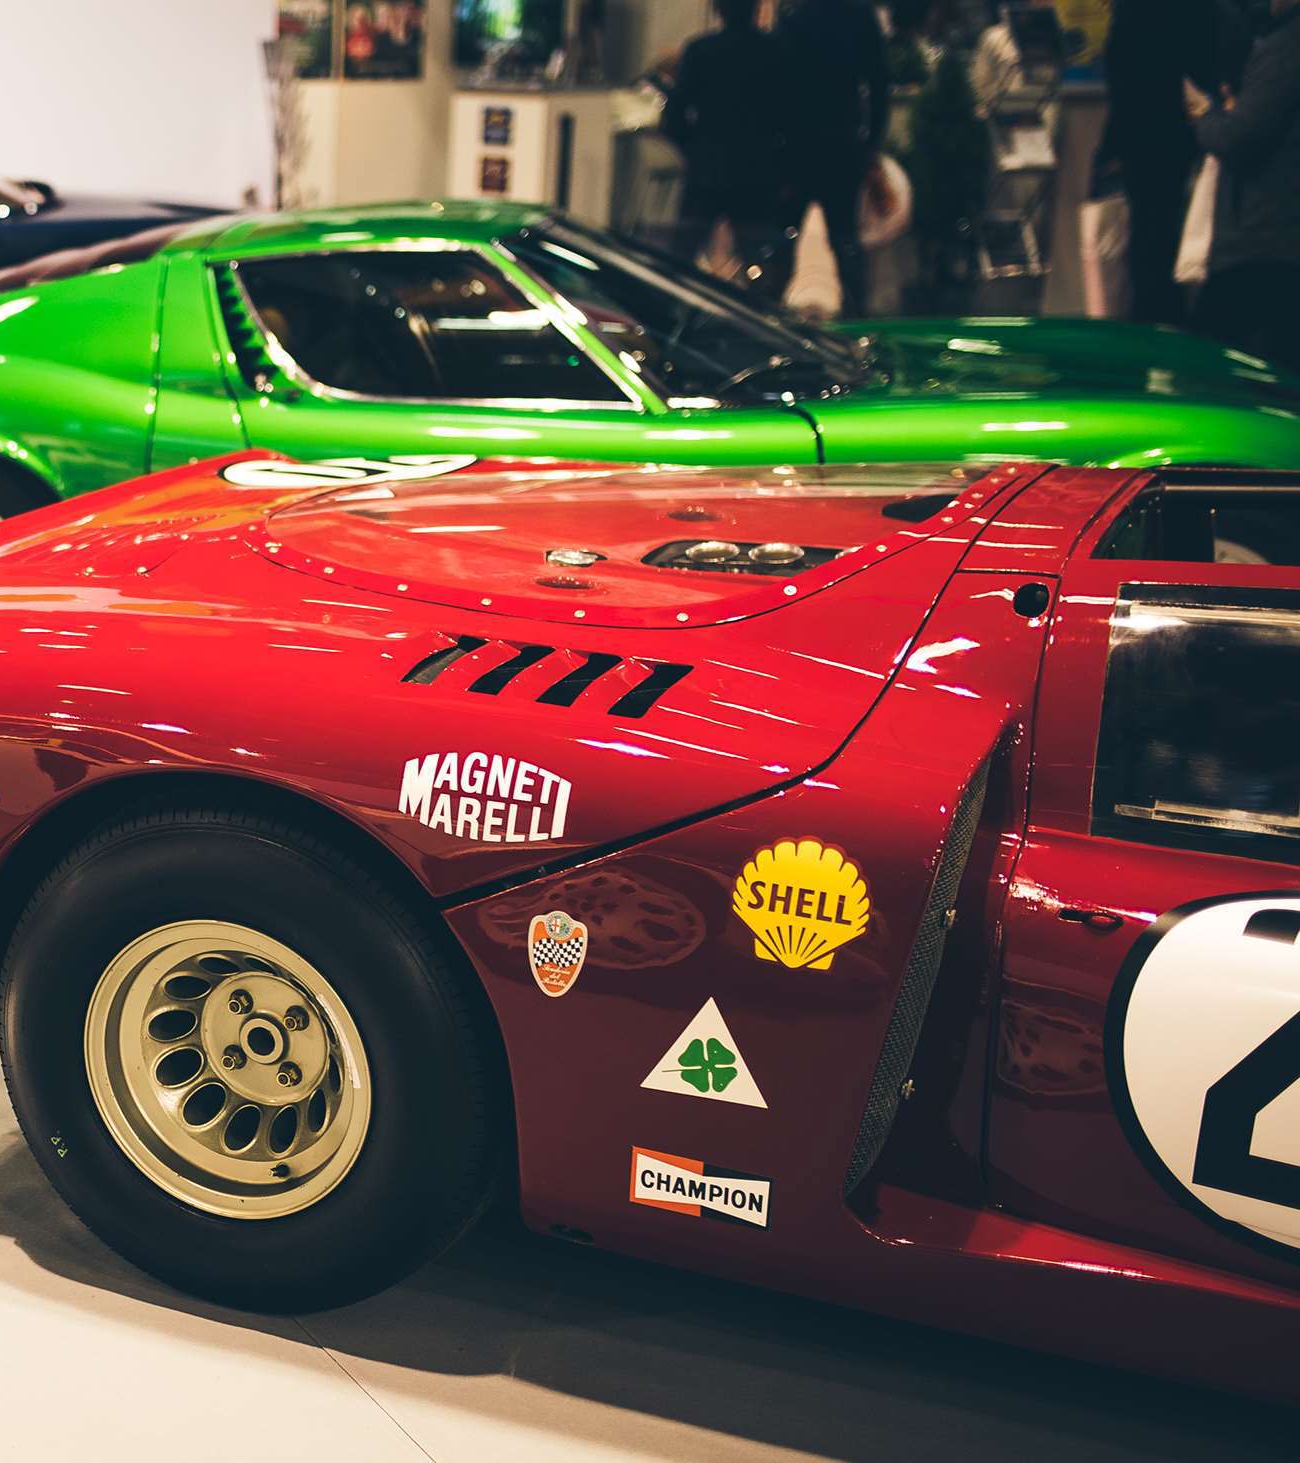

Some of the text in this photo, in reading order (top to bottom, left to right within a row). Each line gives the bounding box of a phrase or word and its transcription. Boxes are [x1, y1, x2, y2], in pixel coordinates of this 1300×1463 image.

[399, 751, 572, 806] MAGNETI
[398, 790, 568, 843] MARELLI
[747, 880, 852, 926] SHELL
[640, 1169, 763, 1213] CHAMPION
